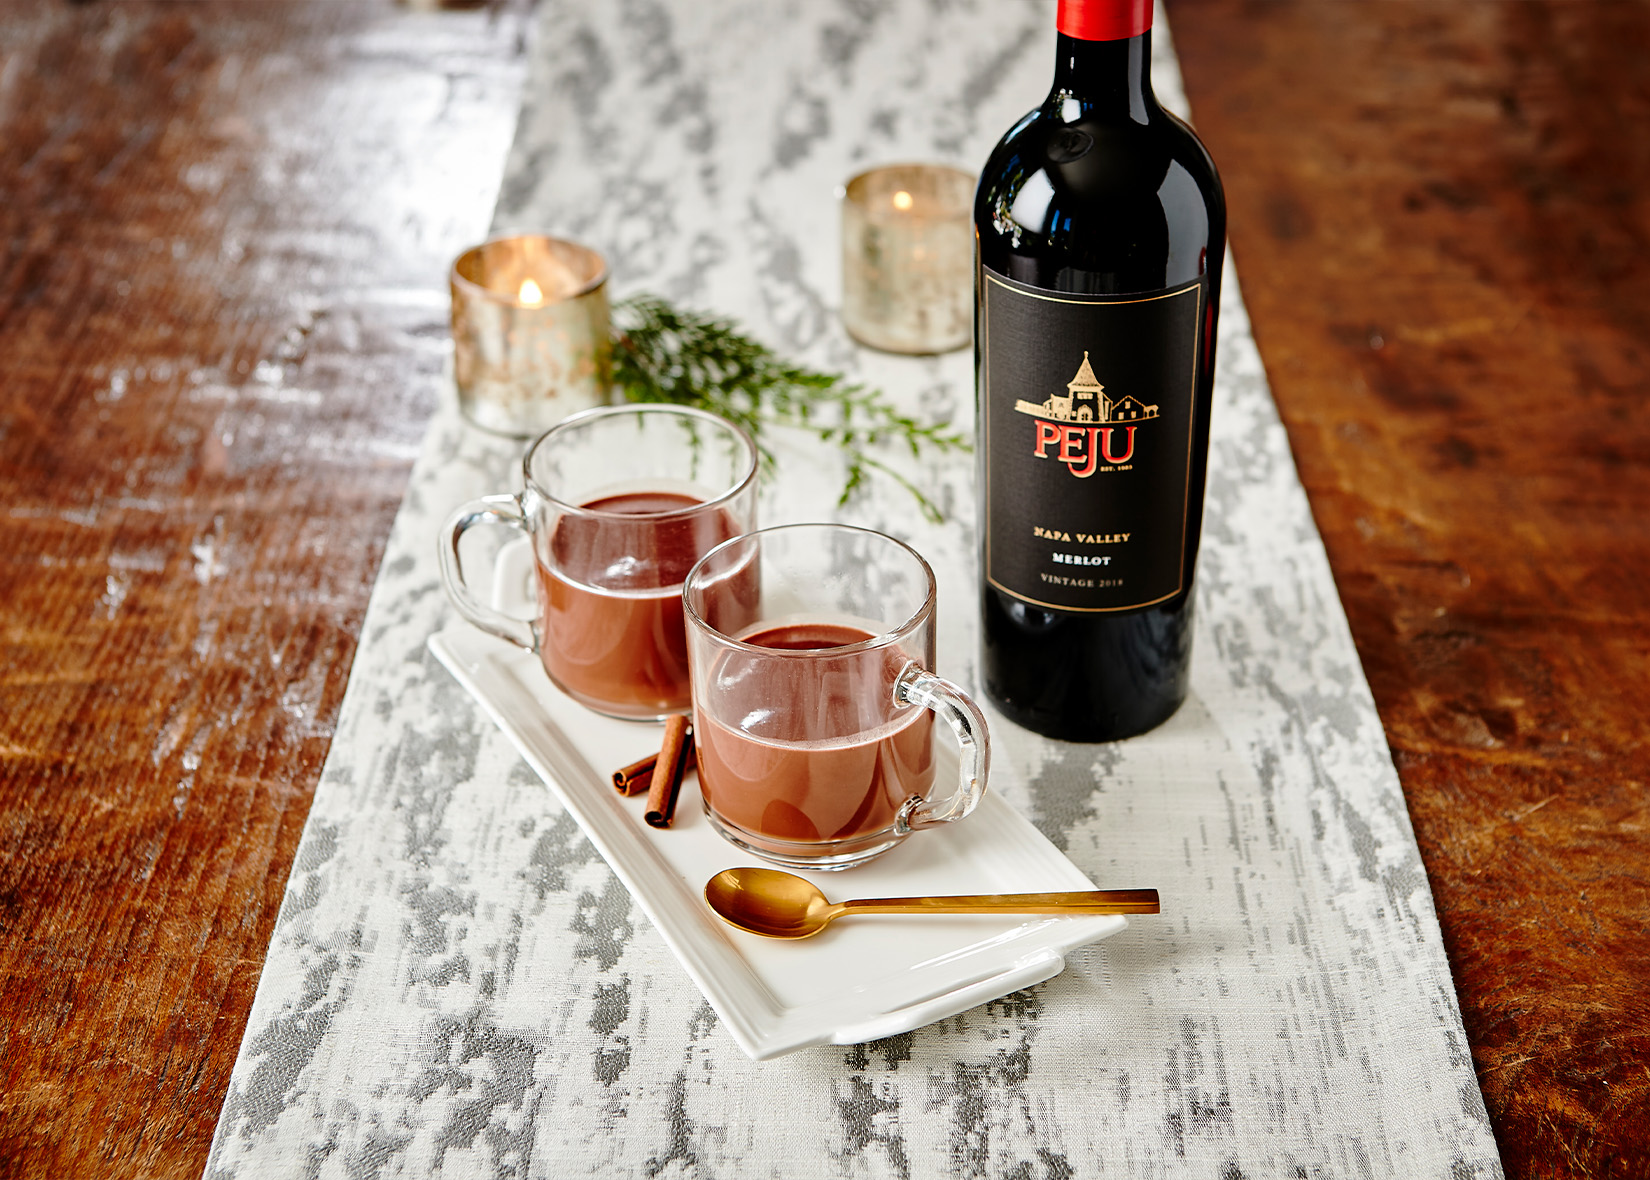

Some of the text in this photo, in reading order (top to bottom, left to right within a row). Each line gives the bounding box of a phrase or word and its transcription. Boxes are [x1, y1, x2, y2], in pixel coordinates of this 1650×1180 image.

[1034, 419, 1137, 478] PEJU
[1033, 526, 1131, 544] NAPA VALLEY
[1052, 552, 1111, 566] MERLOT
[1041, 572, 1094, 588] VINTAGE
